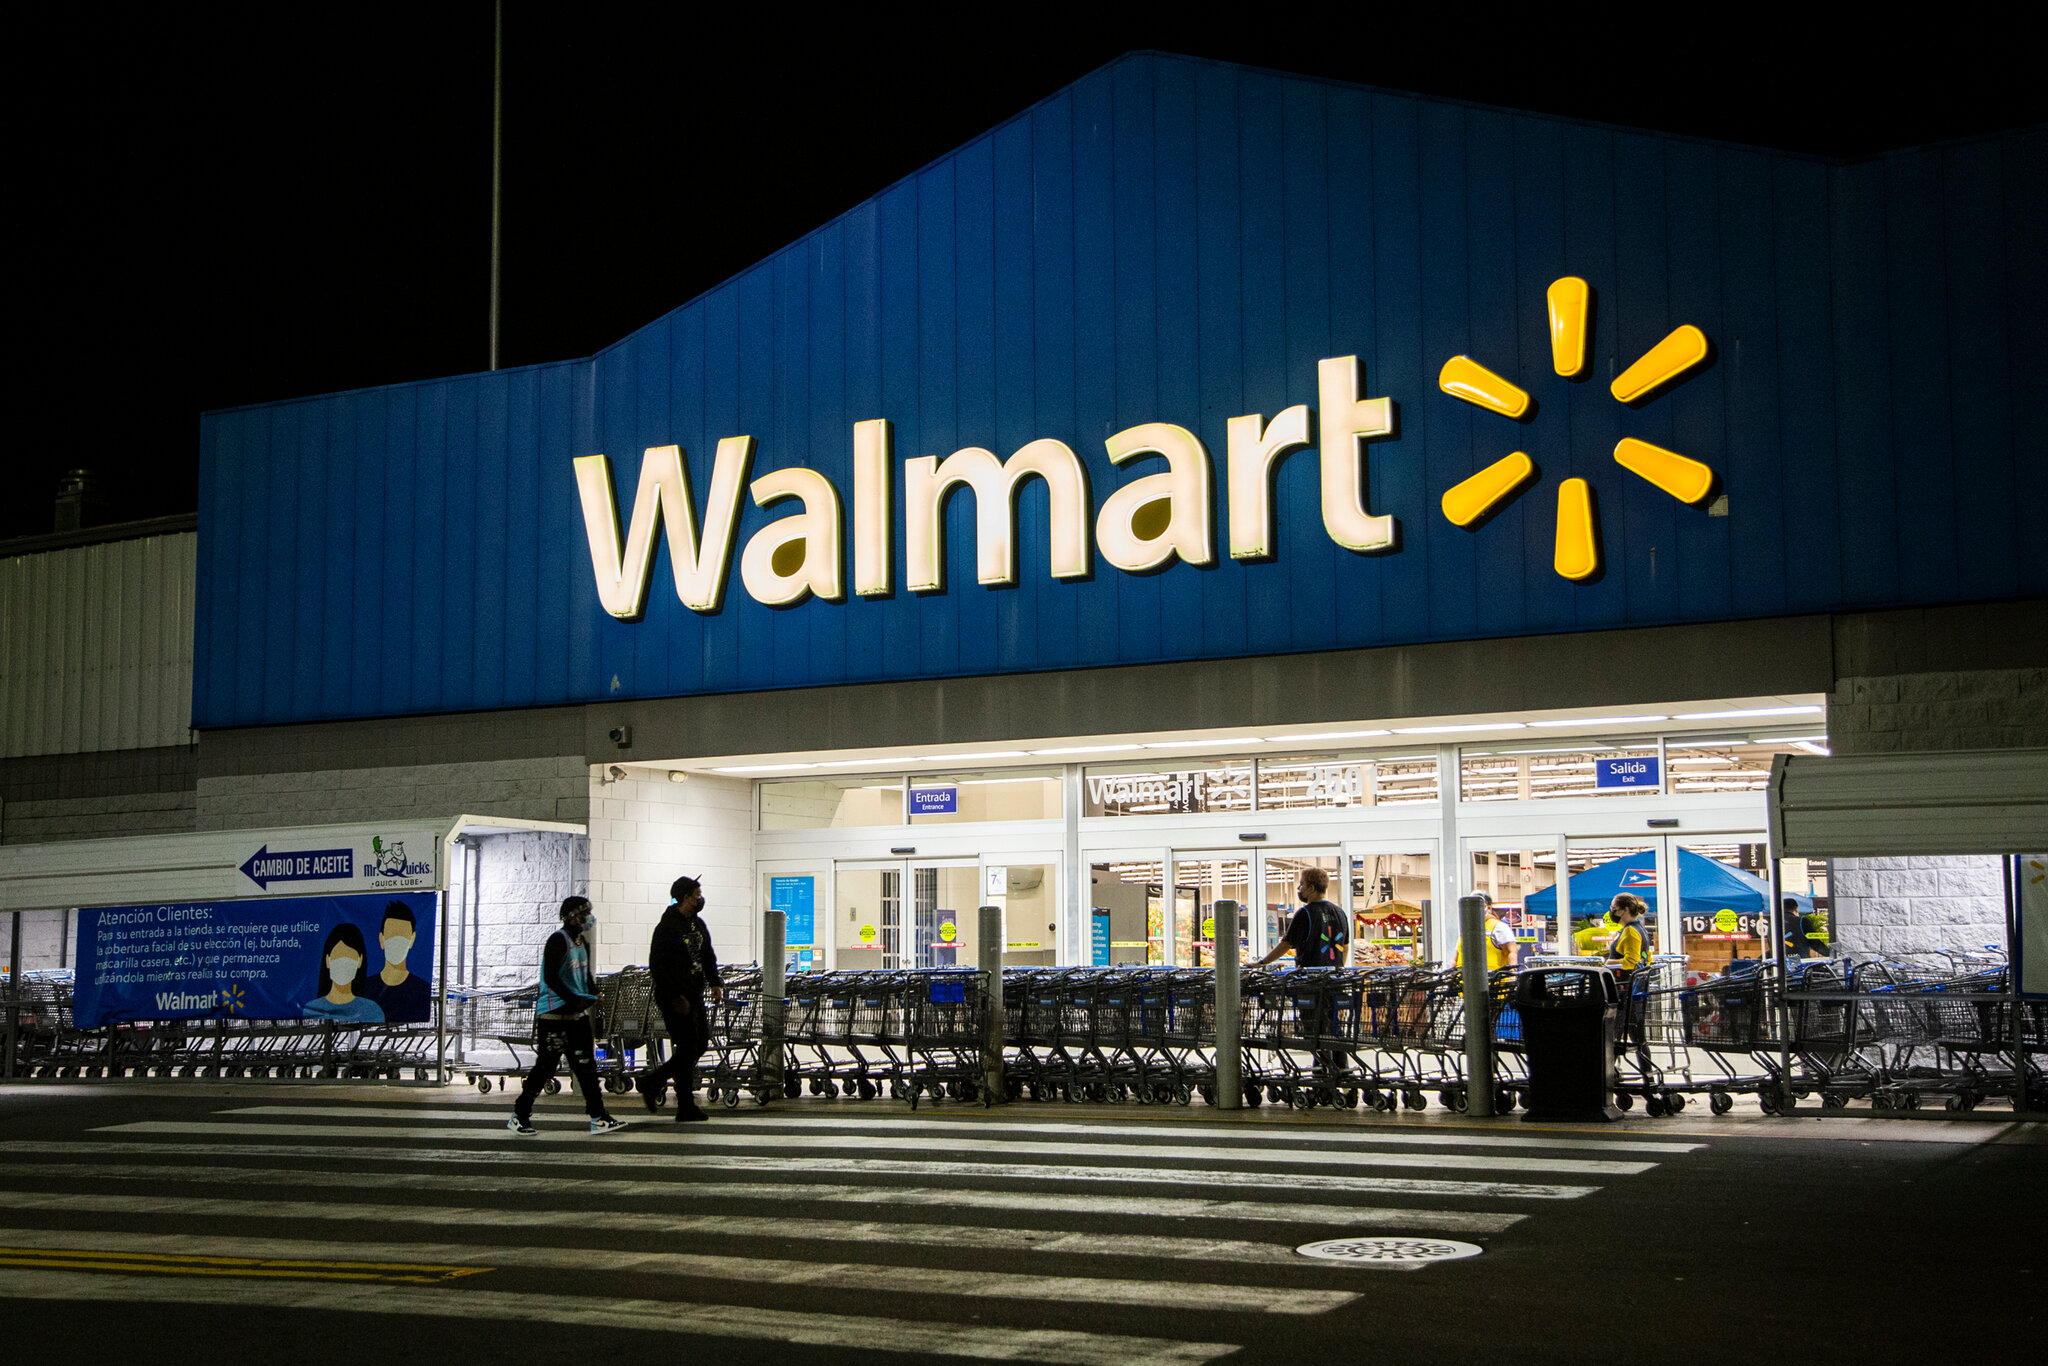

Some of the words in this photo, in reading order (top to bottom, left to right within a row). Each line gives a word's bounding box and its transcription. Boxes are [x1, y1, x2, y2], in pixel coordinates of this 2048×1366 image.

[573, 355, 1397, 620] Walmart
[1609, 760, 1647, 775] Salida
[1088, 773, 1205, 805] Walmart
[1306, 766, 1378, 797] 2501
[1622, 775, 1635, 783] Exit
[915, 791, 951, 804] Entrada
[922, 803, 944, 811] Entrance
[253, 858, 293, 877] CAMBIO
[297, 857, 310, 875] DE
[313, 855, 350, 874] ACEITE
[364, 864, 379, 877] Mr.
[375, 879, 398, 887] QUICK
[400, 878, 419, 886] LUBE
[97, 908, 153, 926] Atención
[157, 906, 213, 922] Clientes:
[116, 931, 128, 940] su
[130, 927, 165, 939] entrada
[167, 929, 172, 937] a
[174, 925, 182, 936] la
[184, 923, 213, 936] tienda
[216, 925, 226, 934] se
[228, 922, 269, 937] requiere
[271, 924, 289, 935] que
[291, 920, 320, 933] utilice
[96, 945, 103, 956] la
[152, 941, 176, 953] facial
[178, 940, 189, 951] de
[190, 941, 202, 950] su
[205, 937, 241, 950] elección
[244, 936, 258, 951] (ej.
[260, 936, 302, 949] bufanda,
[141, 957, 173, 968] casera,
[174, 953, 195, 966] etc.)
[198, 955, 204, 967] y
[222, 954, 280, 967] permanezca
[146, 970, 186, 982] mientras
[215, 969, 227, 979] su
[230, 969, 269, 982] compra.
[156, 990, 218, 1011] Walmart
